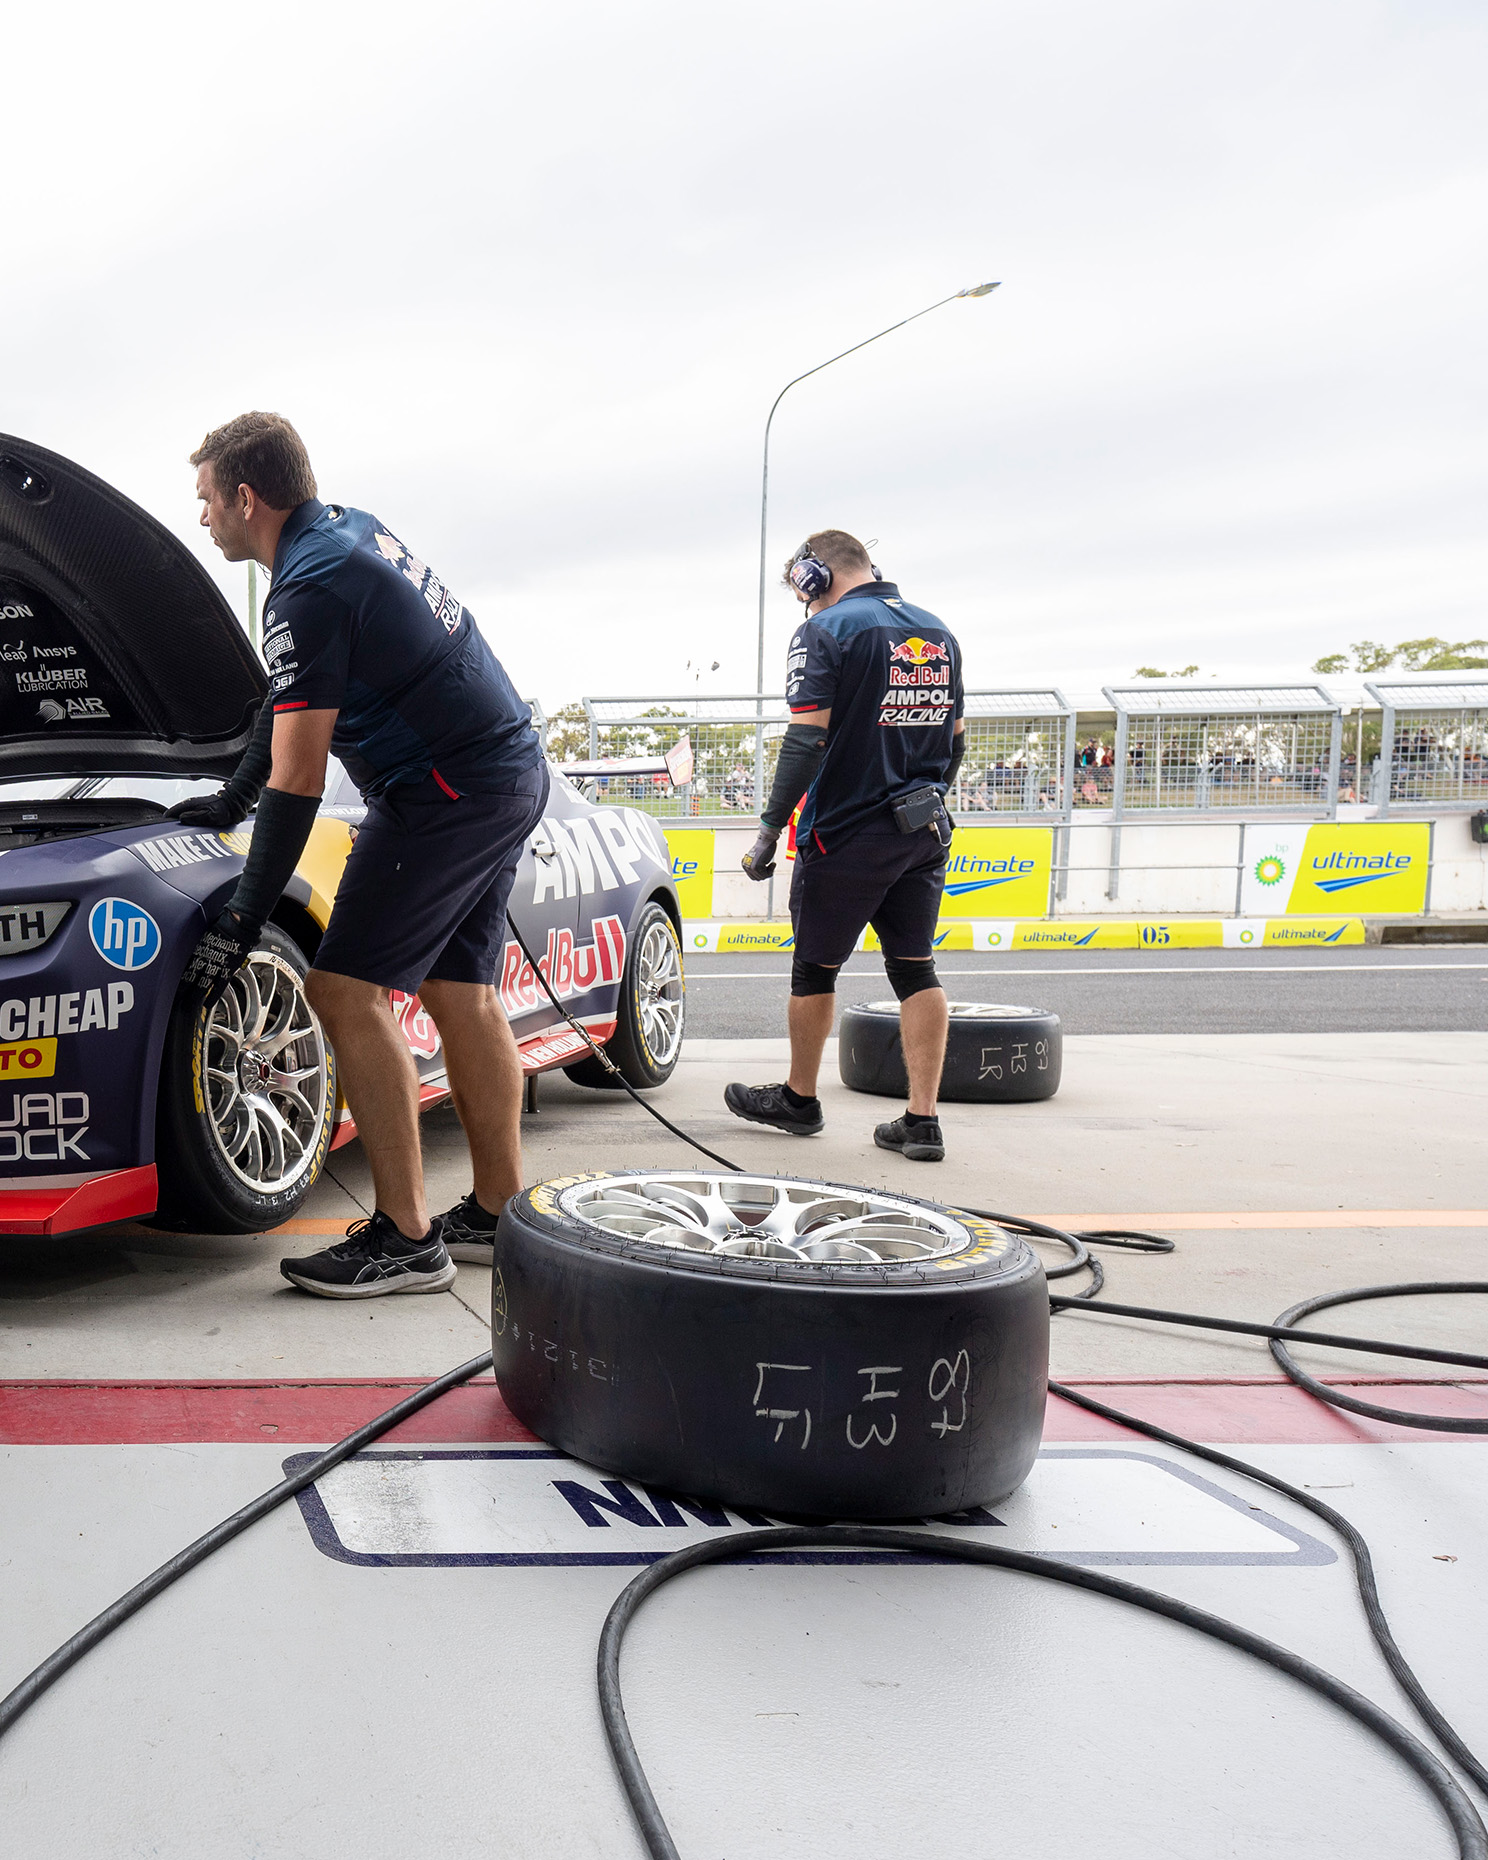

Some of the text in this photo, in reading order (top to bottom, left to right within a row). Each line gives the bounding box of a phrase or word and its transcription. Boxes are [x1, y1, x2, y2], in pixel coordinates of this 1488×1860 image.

[16, 664, 87, 684] KLÜBER
[889, 665, 950, 686] Red Bull
[17, 679, 89, 692] LUBRICATION
[880, 689, 955, 706] AMPOL
[878, 708, 950, 722] RACING
[134, 834, 207, 872] MAKE
[196, 833, 232, 858] IT
[1275, 843, 1289, 853] bp
[1312, 851, 1411, 869] ultimate
[103, 899, 147, 968] hp
[727, 933, 781, 945] ultimate
[1023, 931, 1078, 943] ultimate
[1142, 926, 1171, 945] 05
[1271, 928, 1327, 940] ultimate
[498, 914, 627, 1018] Red Bull
[929, 1348, 970, 1439] 87
[847, 1366, 903, 1450] H3
